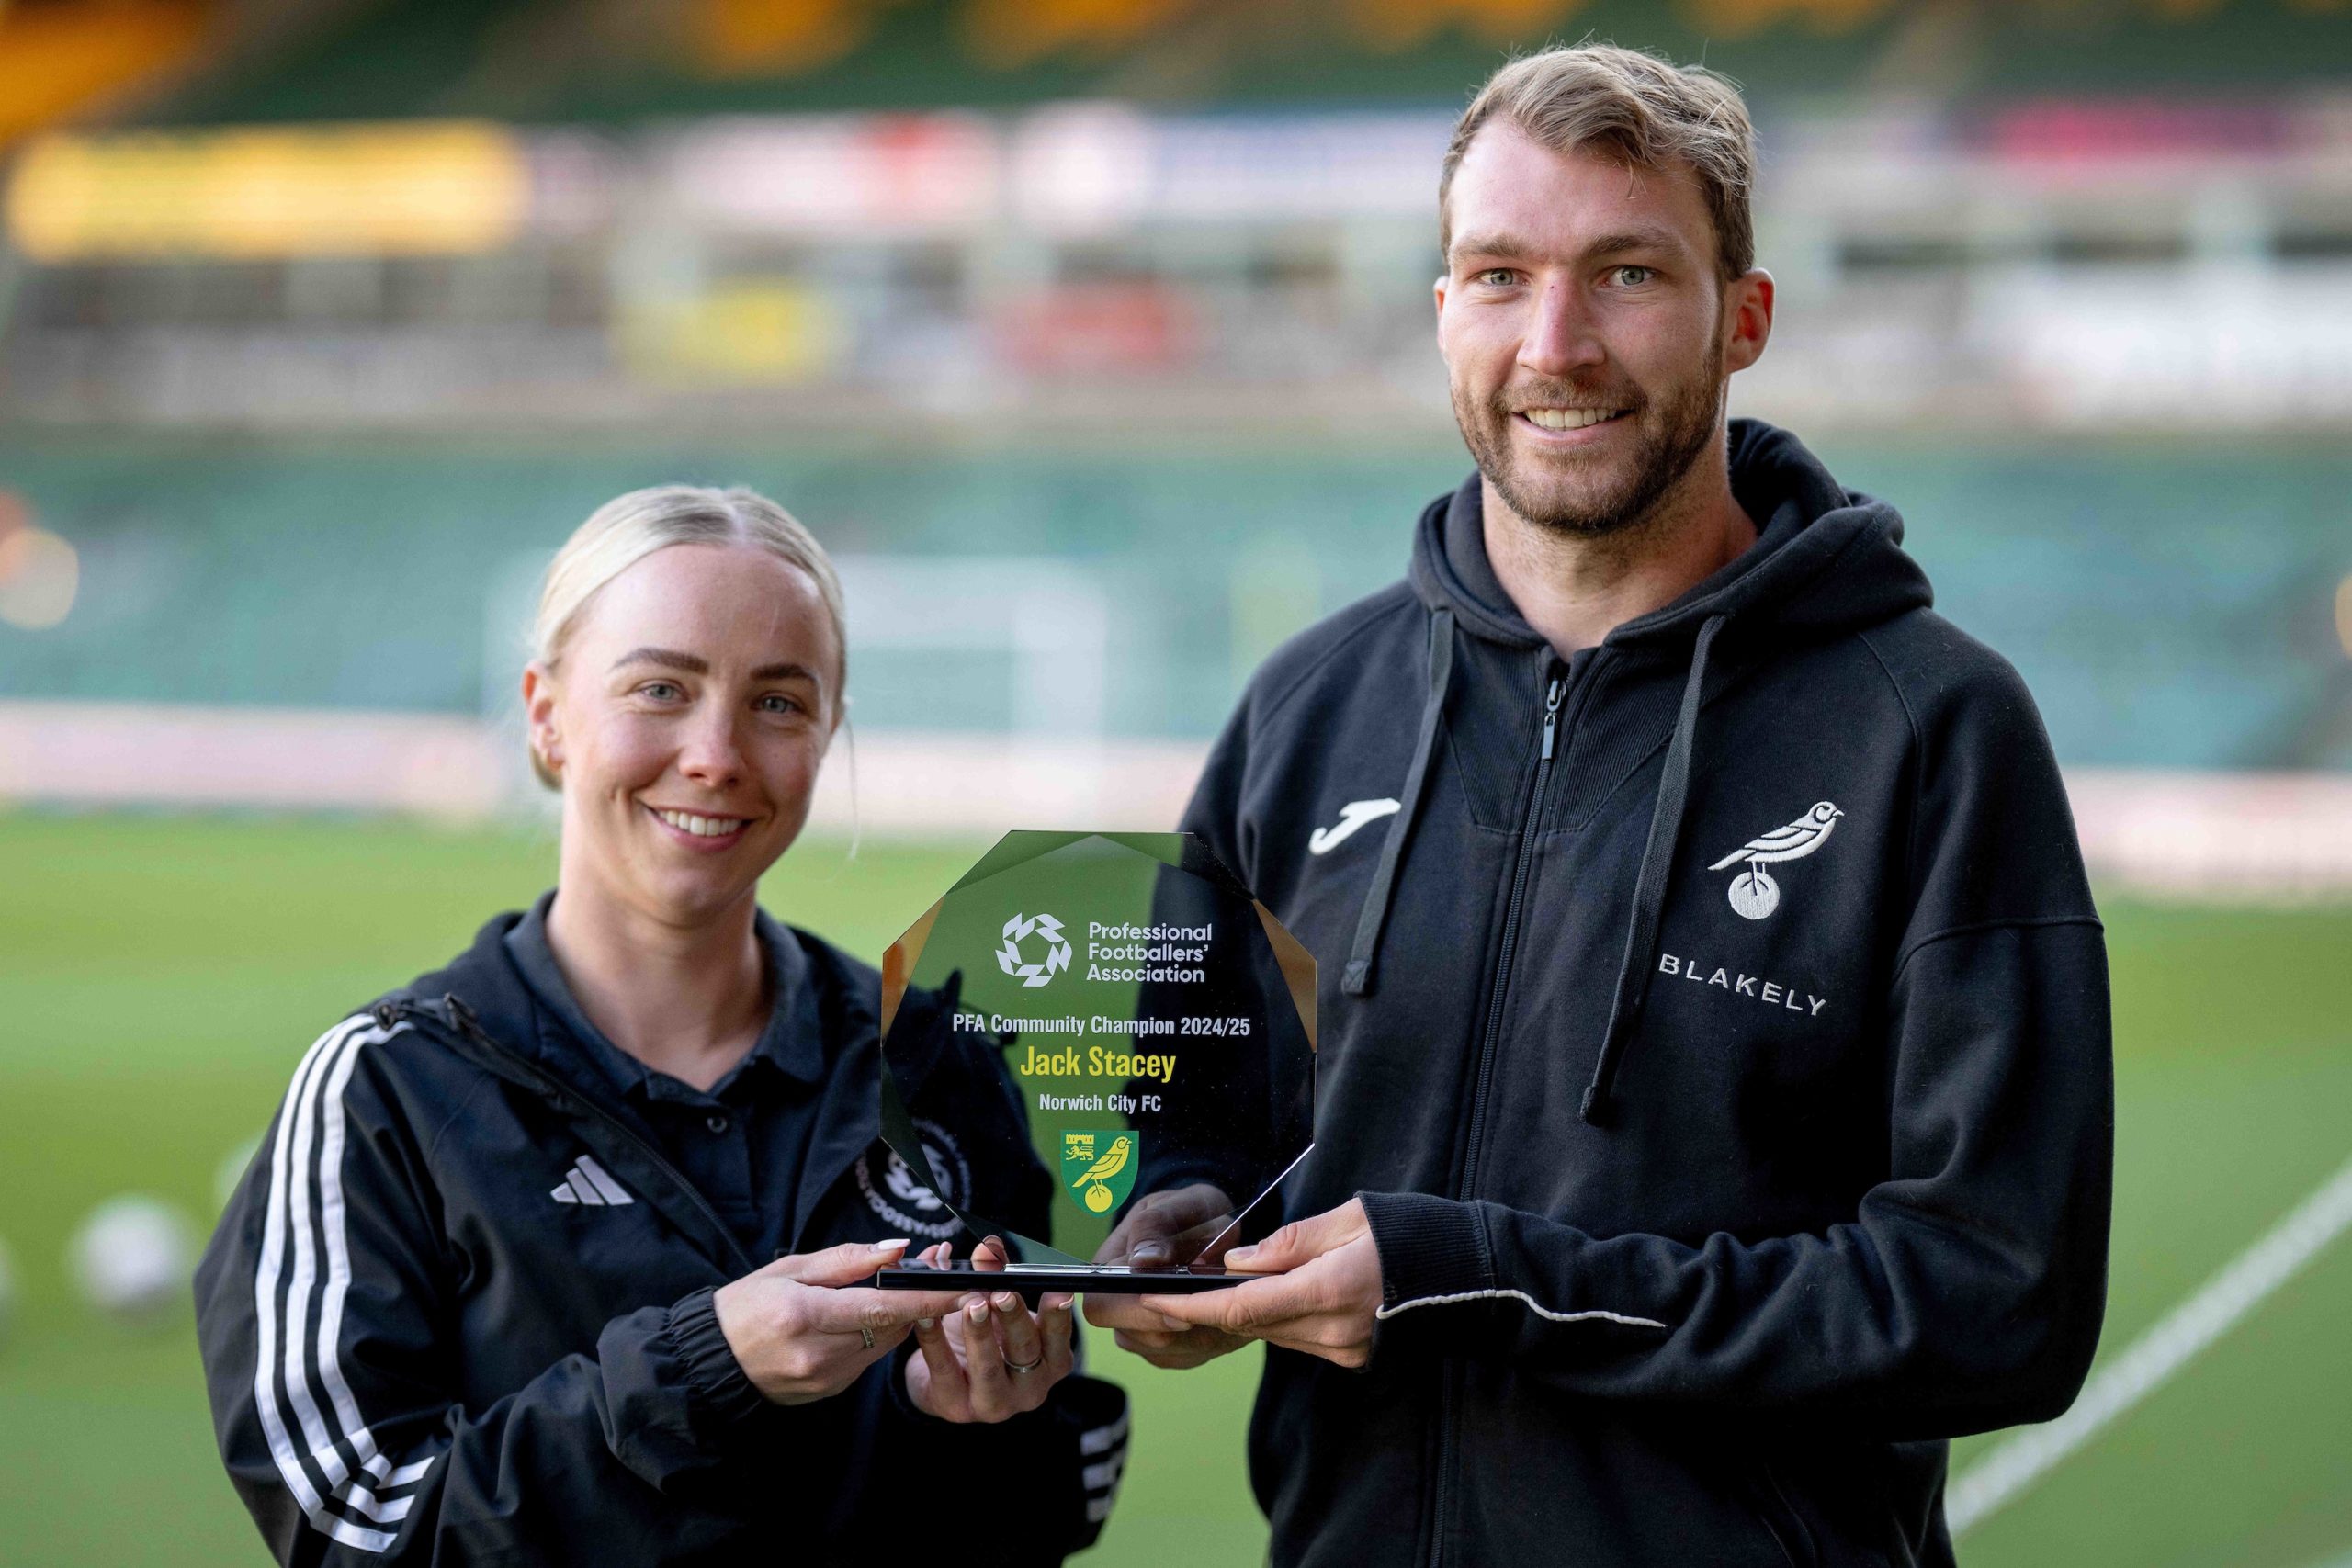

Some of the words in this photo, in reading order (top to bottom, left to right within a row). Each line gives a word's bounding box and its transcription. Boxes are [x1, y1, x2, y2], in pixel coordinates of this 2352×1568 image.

[1088, 921, 1213, 941] Professional
[1088, 942, 1209, 962] Footballers’
[1086, 963, 1205, 983] Association
[1658, 953, 1827, 1017] BLAKELY
[953, 1013, 986, 1032] PFA
[990, 1014, 1086, 1037] Community
[1091, 1015, 1175, 1038] Champion
[1180, 1017, 1250, 1036] 2024/25
[1020, 1045, 1080, 1076] Jack
[1088, 1045, 1176, 1083] Stacey
[1039, 1093, 1102, 1111] Norwich
[1107, 1094, 1137, 1115] City
[1141, 1095, 1161, 1111] FC
